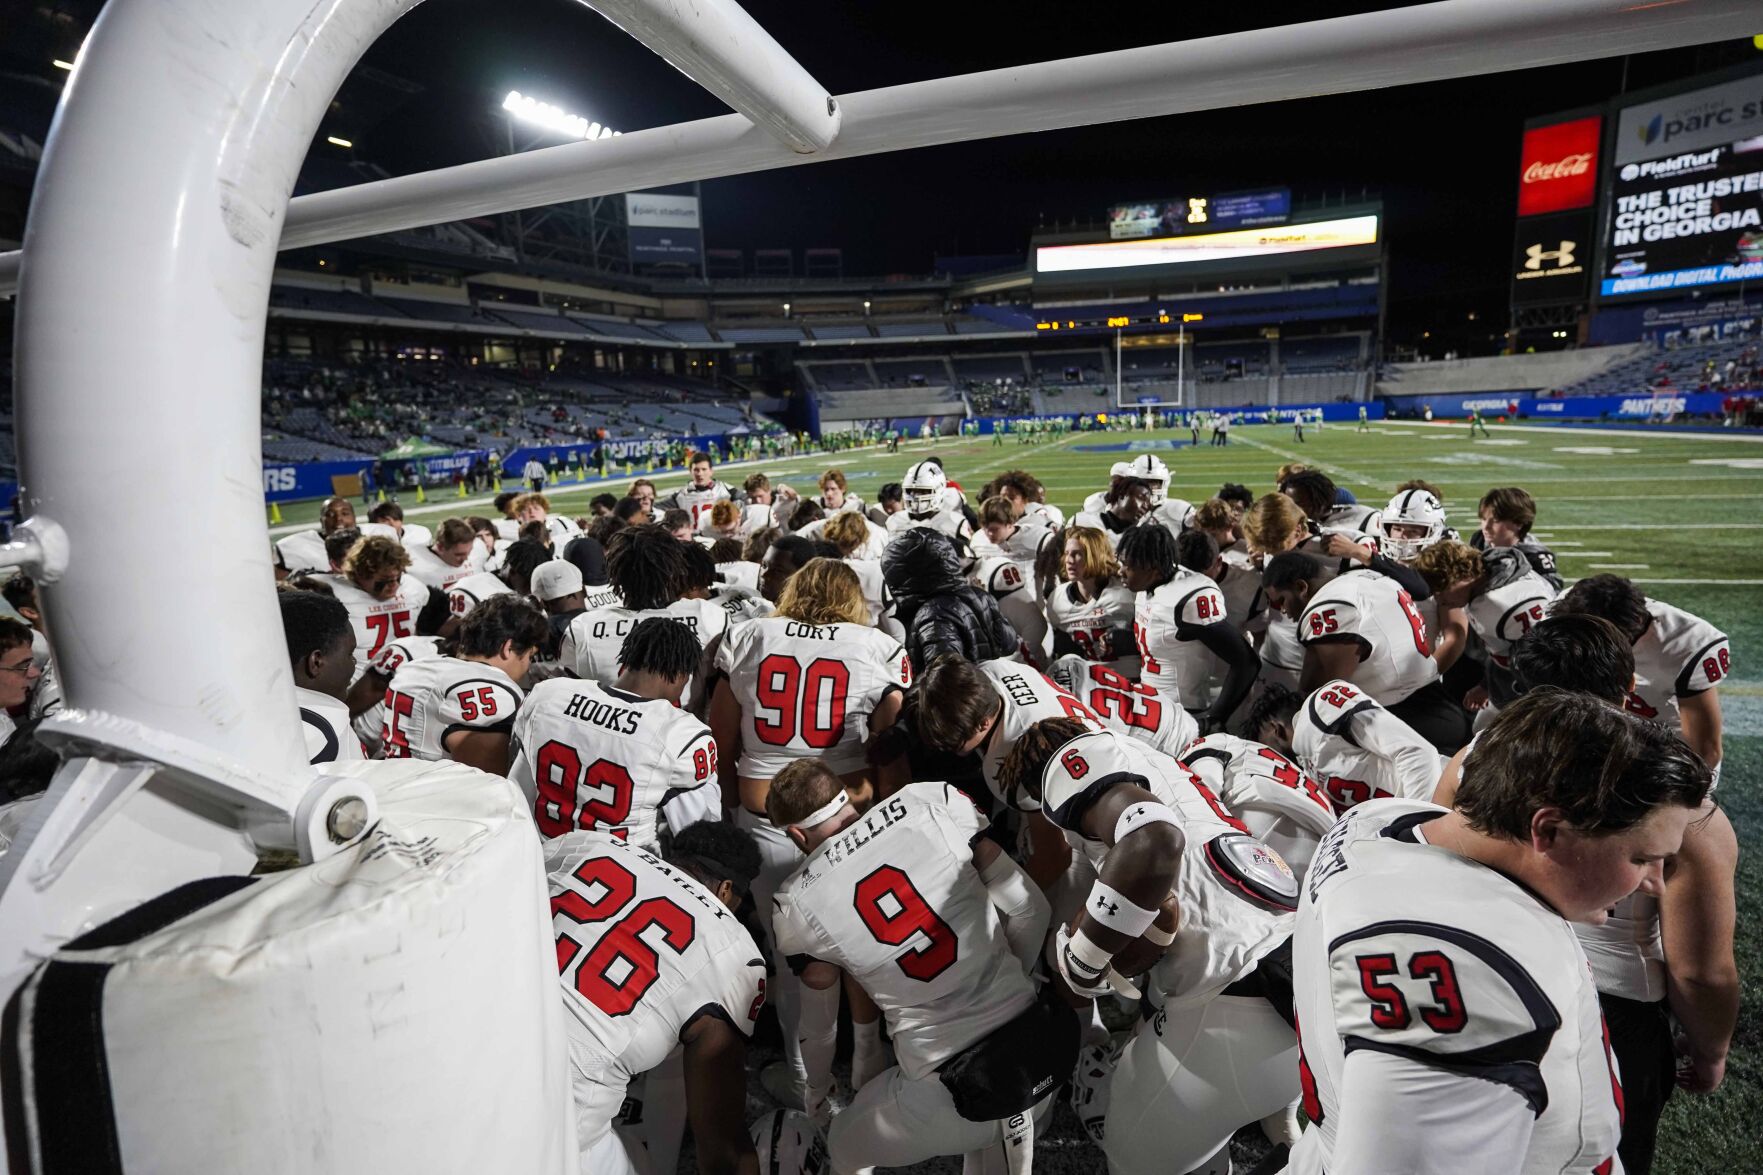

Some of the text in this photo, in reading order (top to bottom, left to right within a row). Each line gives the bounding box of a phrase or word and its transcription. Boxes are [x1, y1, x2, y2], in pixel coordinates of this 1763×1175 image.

[1663, 107, 1734, 143] parc
[1640, 148, 1720, 177] FieldTurf
[1616, 199, 1712, 229] CHOICE
[1617, 190, 1662, 214] THE
[1614, 208, 1760, 246] IN GEORGIA
[1196, 594, 1220, 619] 81
[1309, 609, 1339, 637] 65
[365, 609, 411, 661] 75
[593, 621, 610, 639] Q.
[785, 621, 840, 641] CORY
[457, 687, 498, 722] 55
[754, 653, 850, 749] 90
[1001, 673, 1039, 707] GEER
[1320, 685, 1361, 710] 22
[564, 693, 643, 736] HOOKS
[692, 740, 719, 782] 82
[1060, 748, 1090, 780] 6
[534, 739, 635, 841] 82
[824, 797, 908, 867] WILLIS
[550, 855, 696, 1018] 26
[853, 863, 959, 983] 9
[1355, 949, 1469, 1034] 53
